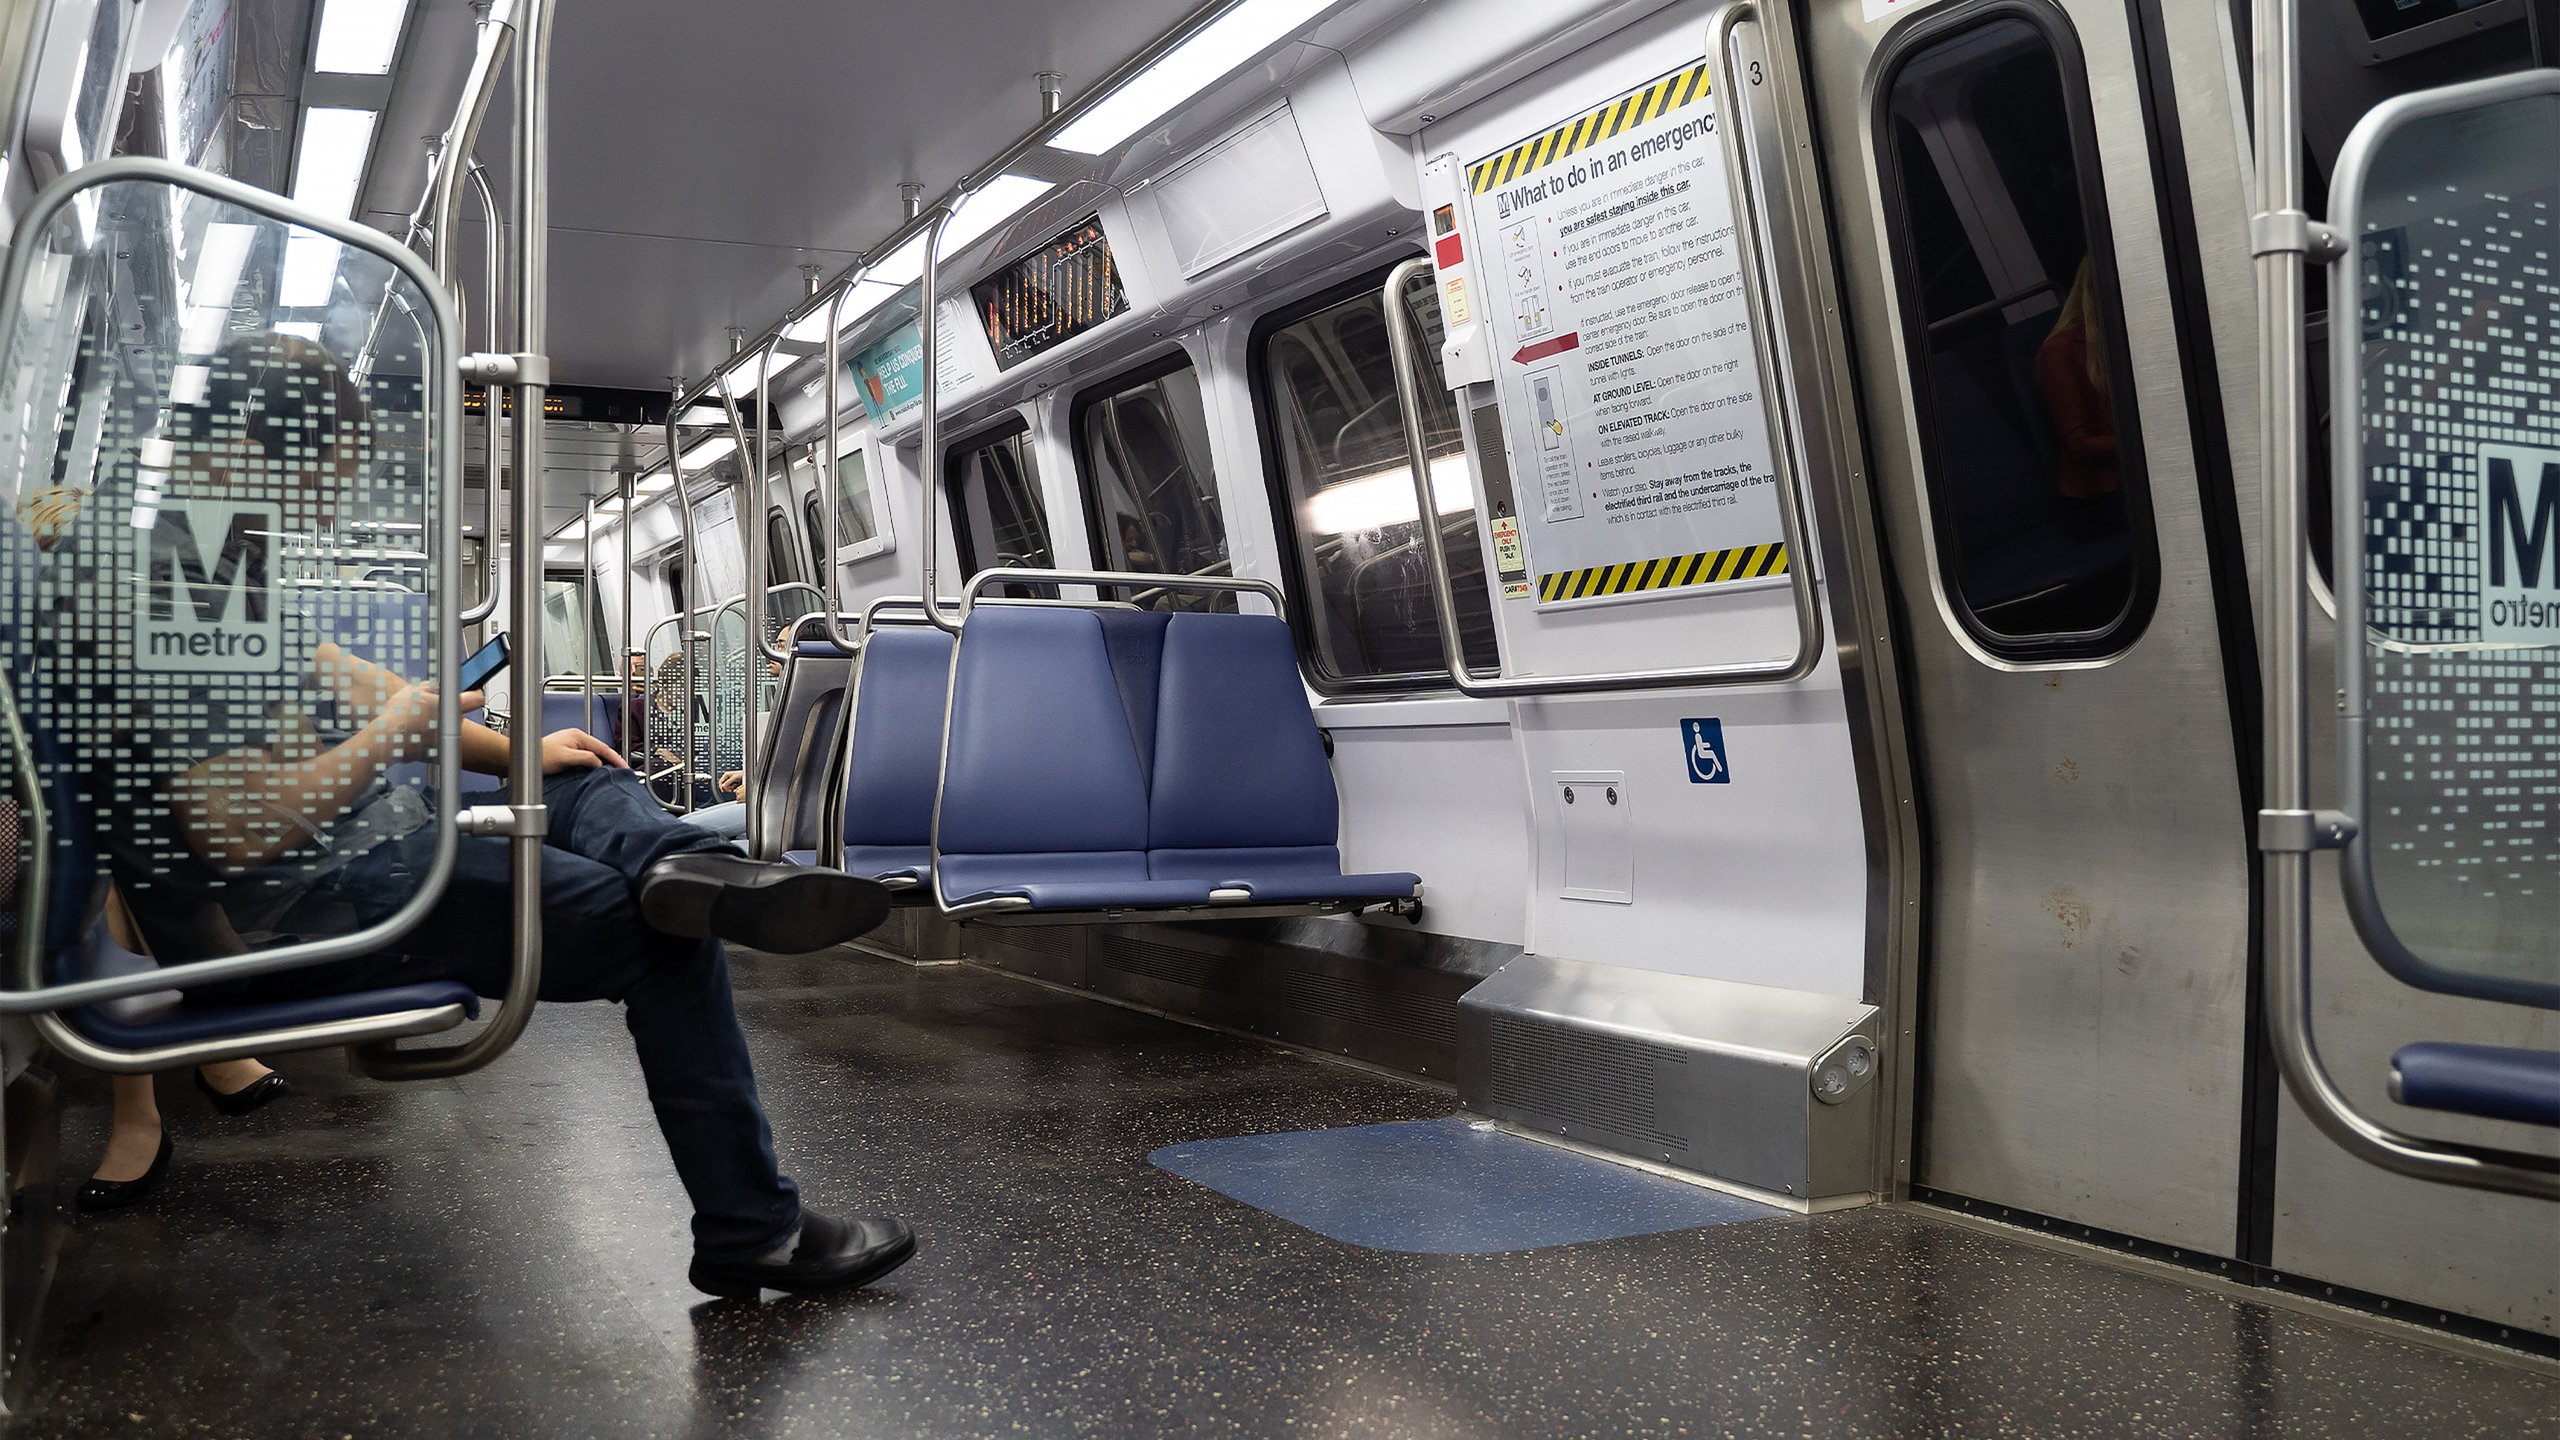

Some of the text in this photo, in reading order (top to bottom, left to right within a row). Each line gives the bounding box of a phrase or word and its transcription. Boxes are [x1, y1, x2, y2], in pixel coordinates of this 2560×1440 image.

[1750, 61, 1763, 86] 3
[1509, 180, 1547, 210] What
[1549, 175, 1564, 195] to
[1567, 165, 1586, 188] do
[1589, 157, 1604, 179] in
[1607, 150, 1627, 172] an
[1559, 179, 1690, 238] you are safest staying inside this car.
[1664, 205, 1677, 218] this
[1681, 239, 1694, 250] the
[1647, 260, 1685, 279] emergency
[1587, 358, 1610, 372] INSIDE
[1609, 349, 1644, 365] TUNNELS:
[1646, 344, 1663, 356] Open
[1664, 341, 1675, 351] the
[1675, 337, 1690, 348] door
[1691, 334, 1700, 344] on
[1701, 331, 1712, 341] the
[1735, 322, 1746, 332] the
[1593, 358, 1738, 404] AT GROUND LEVEL: Open the door on the right
[1597, 423, 1609, 434] ON
[1609, 416, 1642, 432] ELEVATED
[1643, 409, 1670, 423] TRACK:
[1670, 407, 1688, 419] Open
[1688, 404, 1699, 414] the
[1700, 400, 1715, 411] door
[1716, 398, 1726, 408] on
[1726, 395, 1737, 405] the
[1725, 428, 1743, 440] bulky
[1648, 479, 1663, 489] Stay
[1664, 476, 1682, 486] away
[1682, 473, 1700, 482] from
[1700, 469, 1712, 479] the
[1713, 465, 1738, 477] tracks,
[1739, 462, 1751, 472] the
[1604, 475, 1762, 511] electrified third rail and the undercarriage of the
[1494, 530, 1517, 539] EMERGENCY
[149, 510, 269, 622] M
[151, 626, 268, 657] metro
